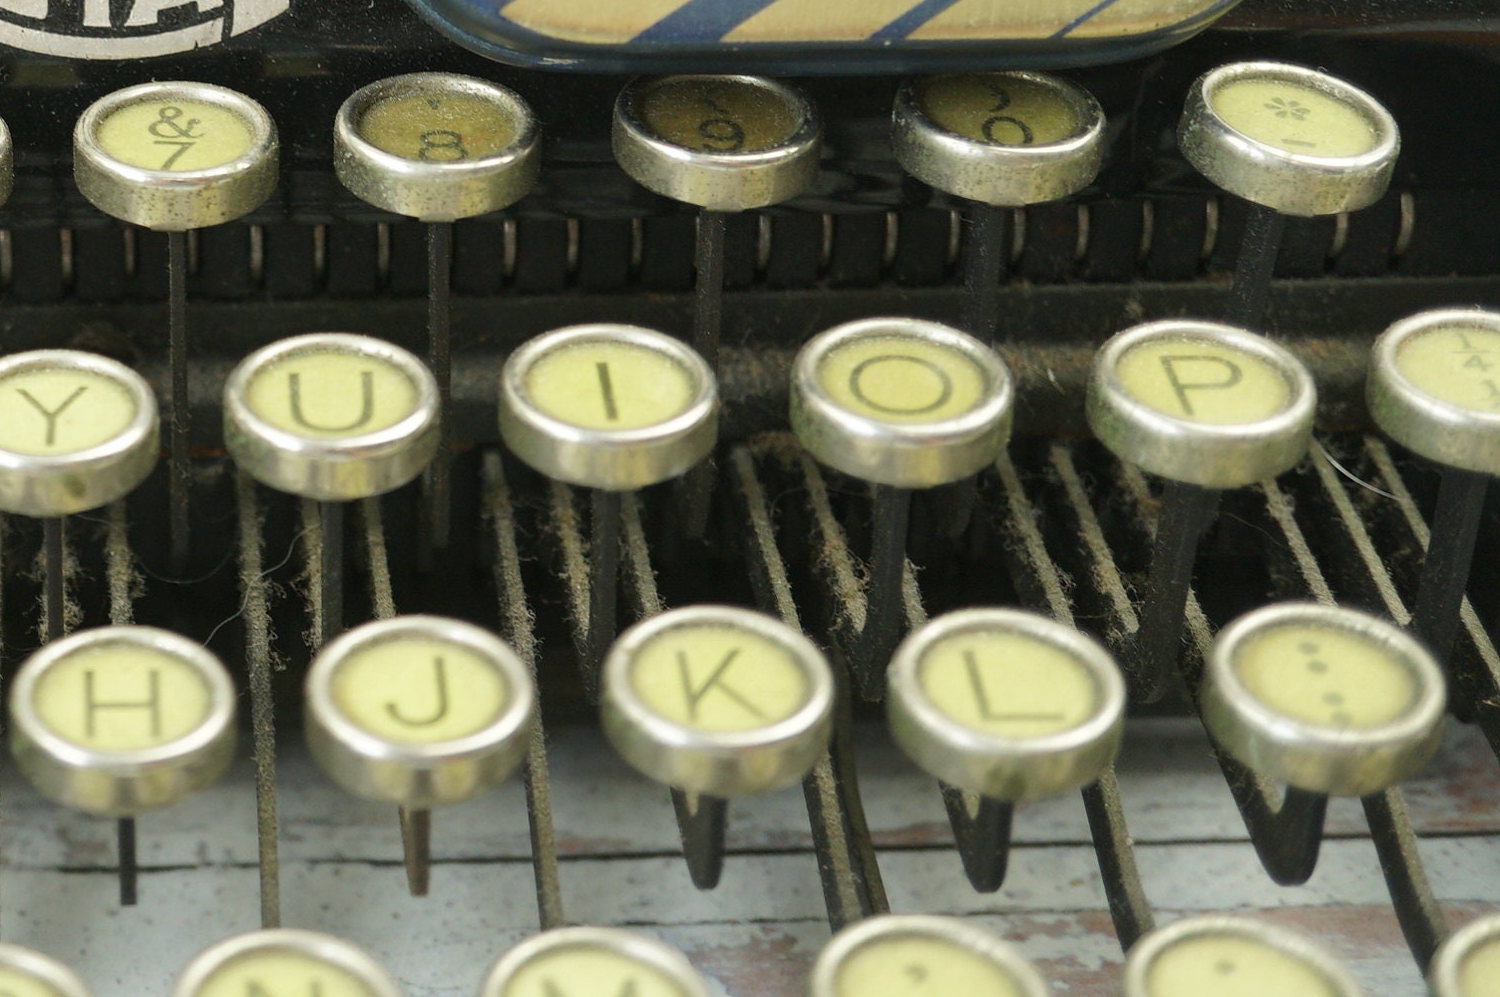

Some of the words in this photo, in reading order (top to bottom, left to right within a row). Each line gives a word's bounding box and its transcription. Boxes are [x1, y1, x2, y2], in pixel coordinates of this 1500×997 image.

[152, 139, 197, 170] 7
[15, 385, 88, 448] Y
[288, 369, 375, 434] U
[1158, 354, 1243, 417] P
[82, 668, 162, 738] H
[382, 655, 448, 729] J
[676, 648, 773, 722] K
[962, 650, 1066, 724] L
